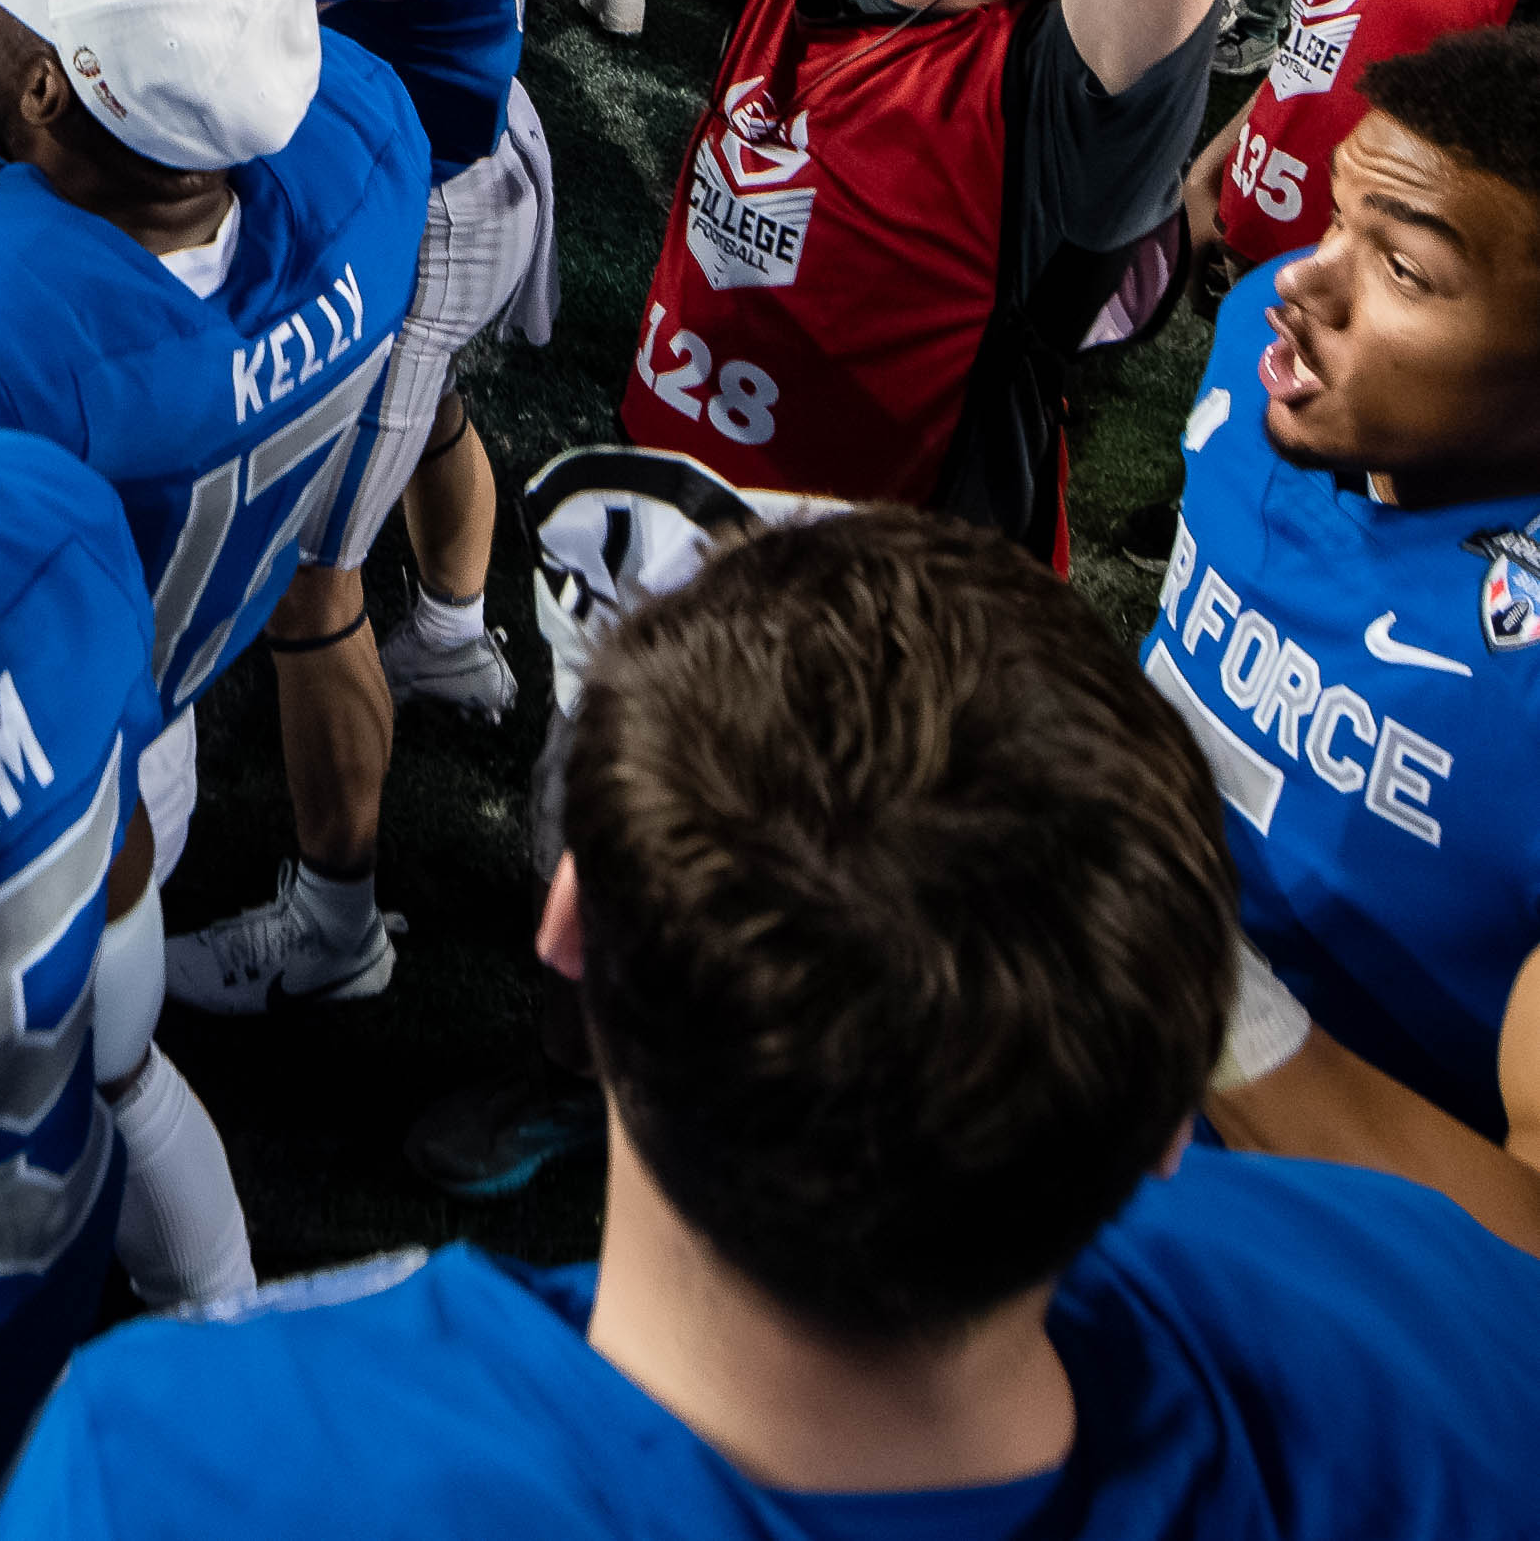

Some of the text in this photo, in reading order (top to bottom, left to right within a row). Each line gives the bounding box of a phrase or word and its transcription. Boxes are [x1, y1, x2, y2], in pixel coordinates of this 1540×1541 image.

[1230, 122, 1310, 224] 135
[229, 261, 371, 426] KELLY
[636, 300, 780, 448] 128
[151, 332, 396, 707] 17
[1182, 566, 1456, 850] FORCE
